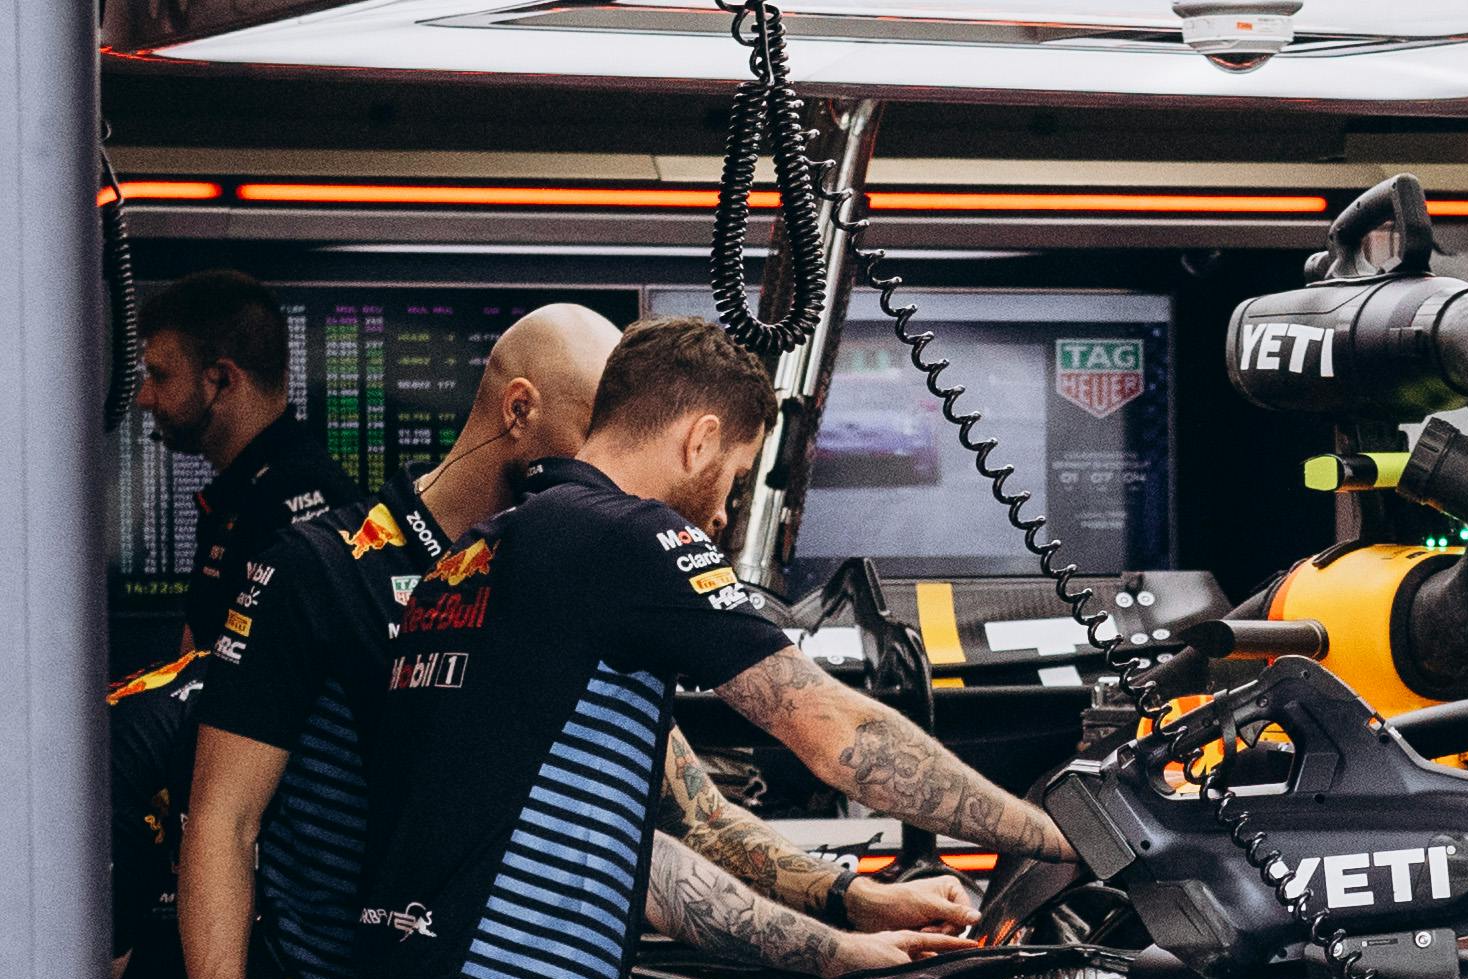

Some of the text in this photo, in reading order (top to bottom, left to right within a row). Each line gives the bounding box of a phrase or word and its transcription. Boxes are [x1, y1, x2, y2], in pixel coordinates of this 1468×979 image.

[1069, 345, 1138, 369] TAG
[1239, 322, 1335, 378] YETI
[406, 510, 442, 558] zoom
[1269, 845, 1452, 912] YETI
